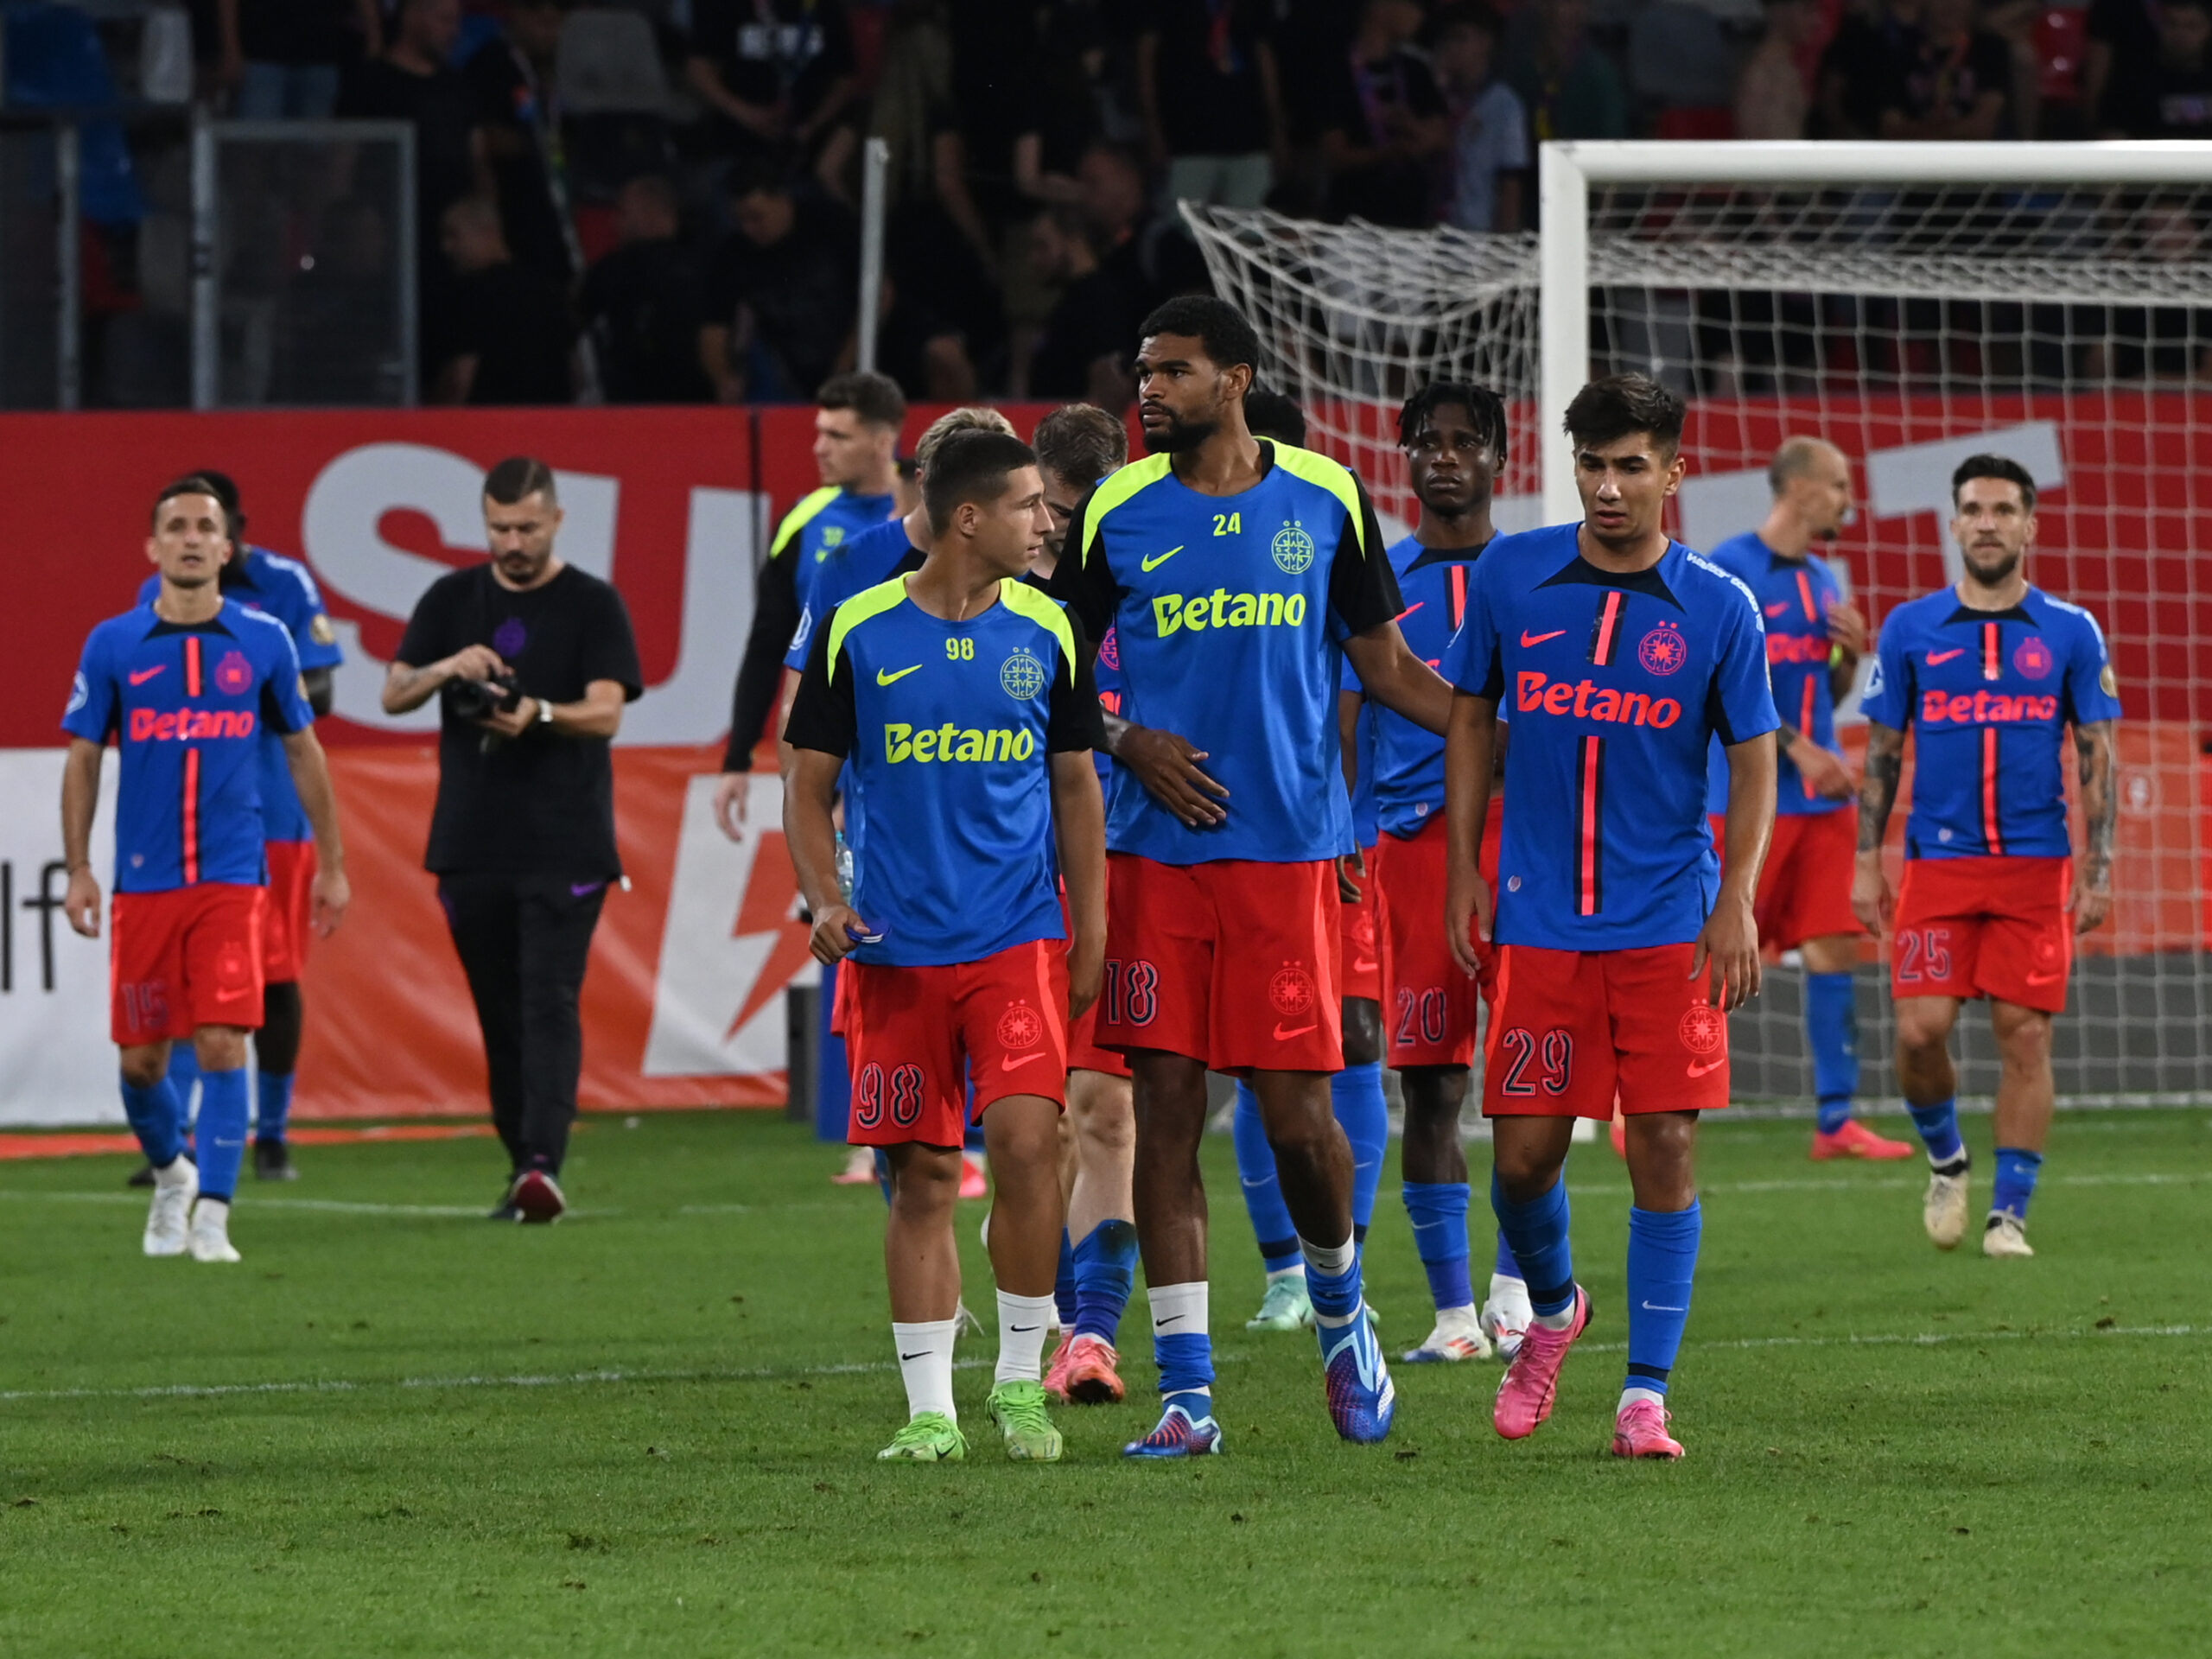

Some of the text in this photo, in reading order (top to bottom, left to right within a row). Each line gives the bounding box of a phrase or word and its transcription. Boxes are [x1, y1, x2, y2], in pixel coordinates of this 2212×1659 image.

[1213, 512, 1241, 537] 24
[1152, 588, 1306, 638] Betano
[945, 637, 975, 661] 98
[130, 707, 255, 742] Betano
[1517, 671, 1682, 728] Betano
[1923, 690, 2058, 723] Betano
[885, 722, 1034, 764] Betano
[1897, 929, 1950, 983] 25
[1105, 958, 1159, 1027] 18
[1395, 987, 1446, 1047] 20
[1503, 1028, 1573, 1096] 29
[856, 1062, 925, 1129] 98
